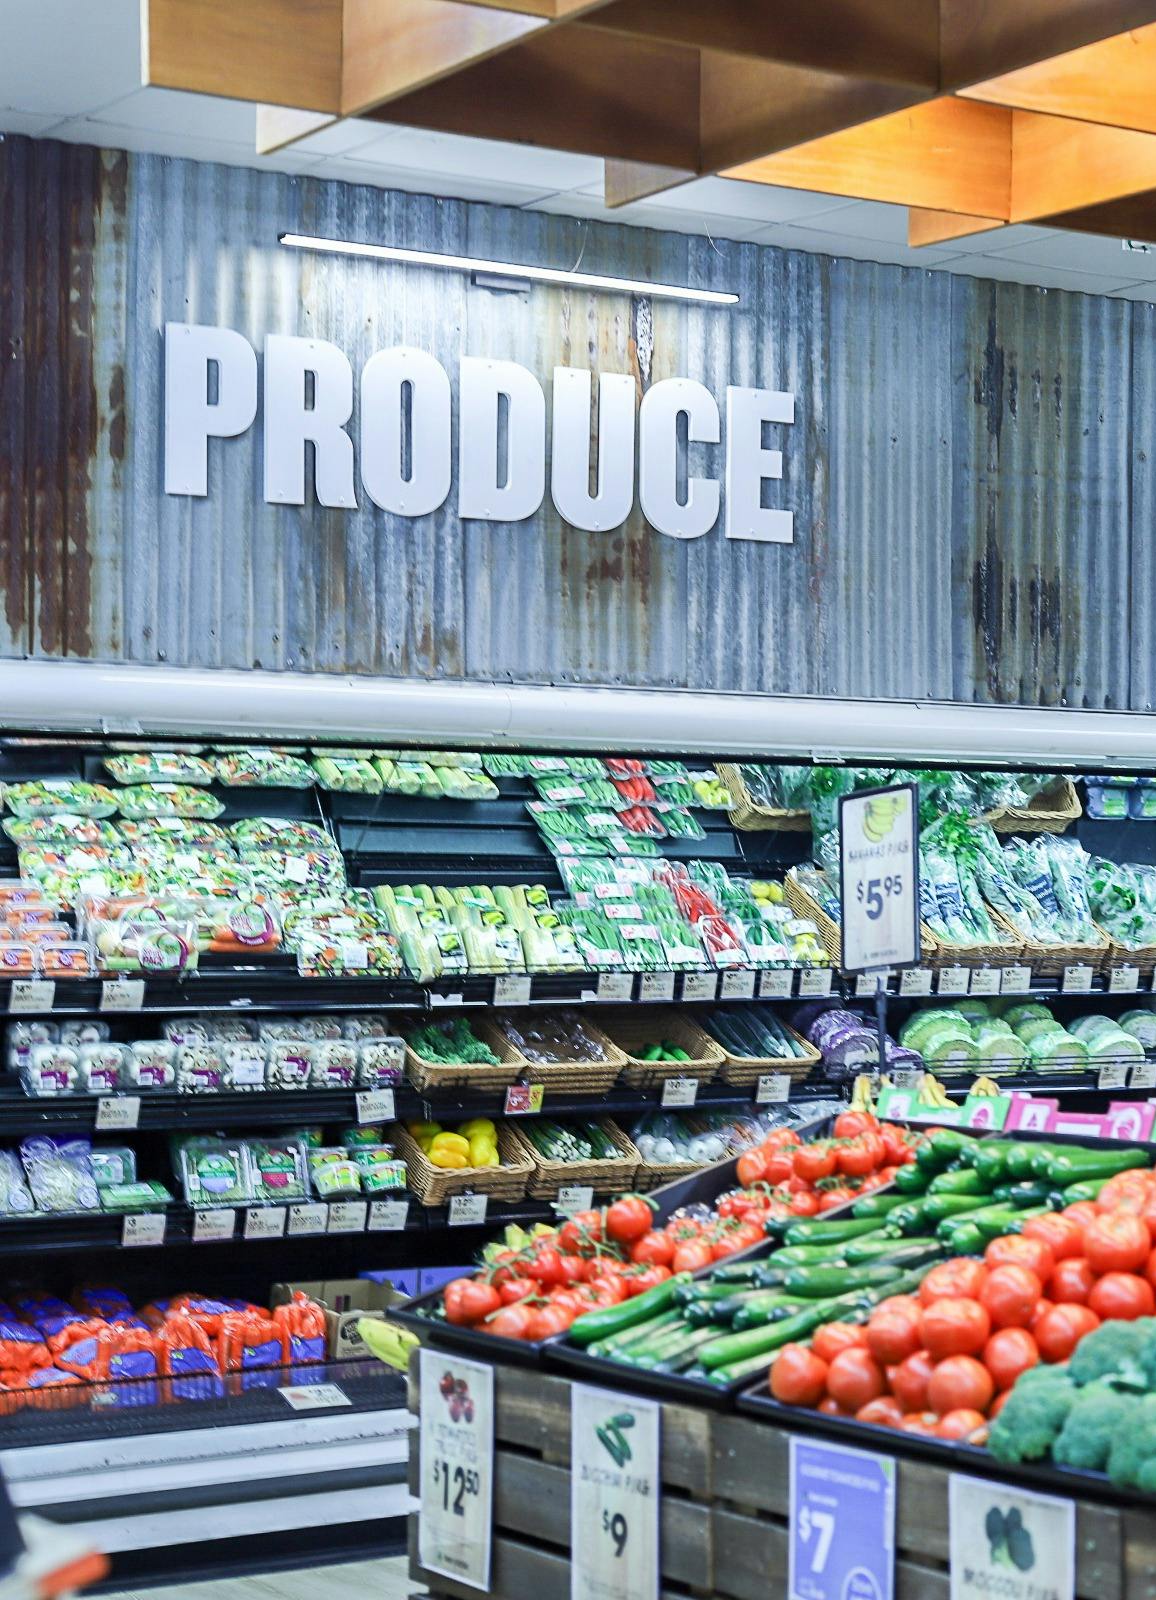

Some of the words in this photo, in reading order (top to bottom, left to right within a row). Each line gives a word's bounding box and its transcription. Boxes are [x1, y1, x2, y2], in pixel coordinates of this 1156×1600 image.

[164, 322, 796, 544] PRODUCE
[602, 1508, 629, 1558] $9
[798, 1504, 835, 1574] $7
